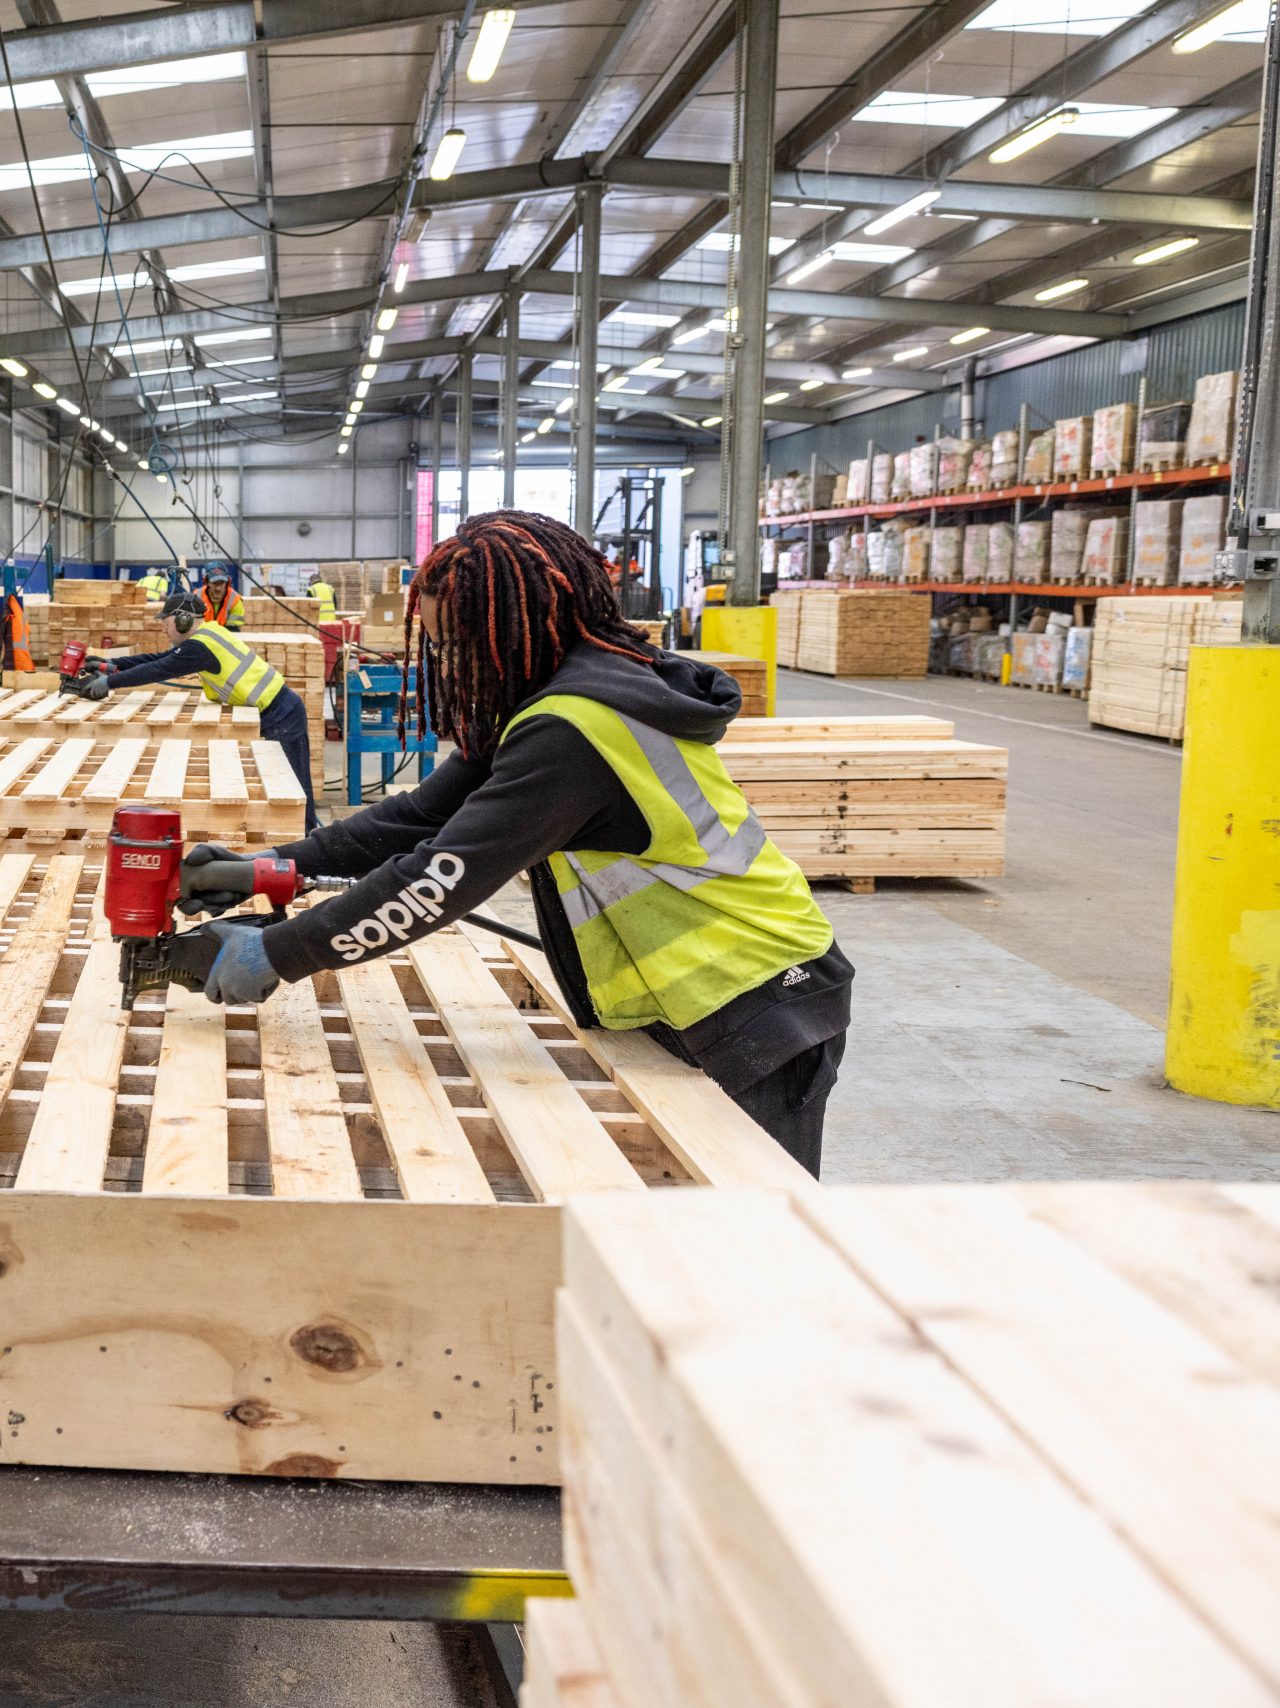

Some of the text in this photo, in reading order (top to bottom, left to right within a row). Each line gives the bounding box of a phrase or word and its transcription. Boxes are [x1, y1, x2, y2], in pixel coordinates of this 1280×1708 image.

[121, 853, 160, 866] SENCO
[330, 852, 466, 961] adidas
[782, 971, 810, 987] adidas
